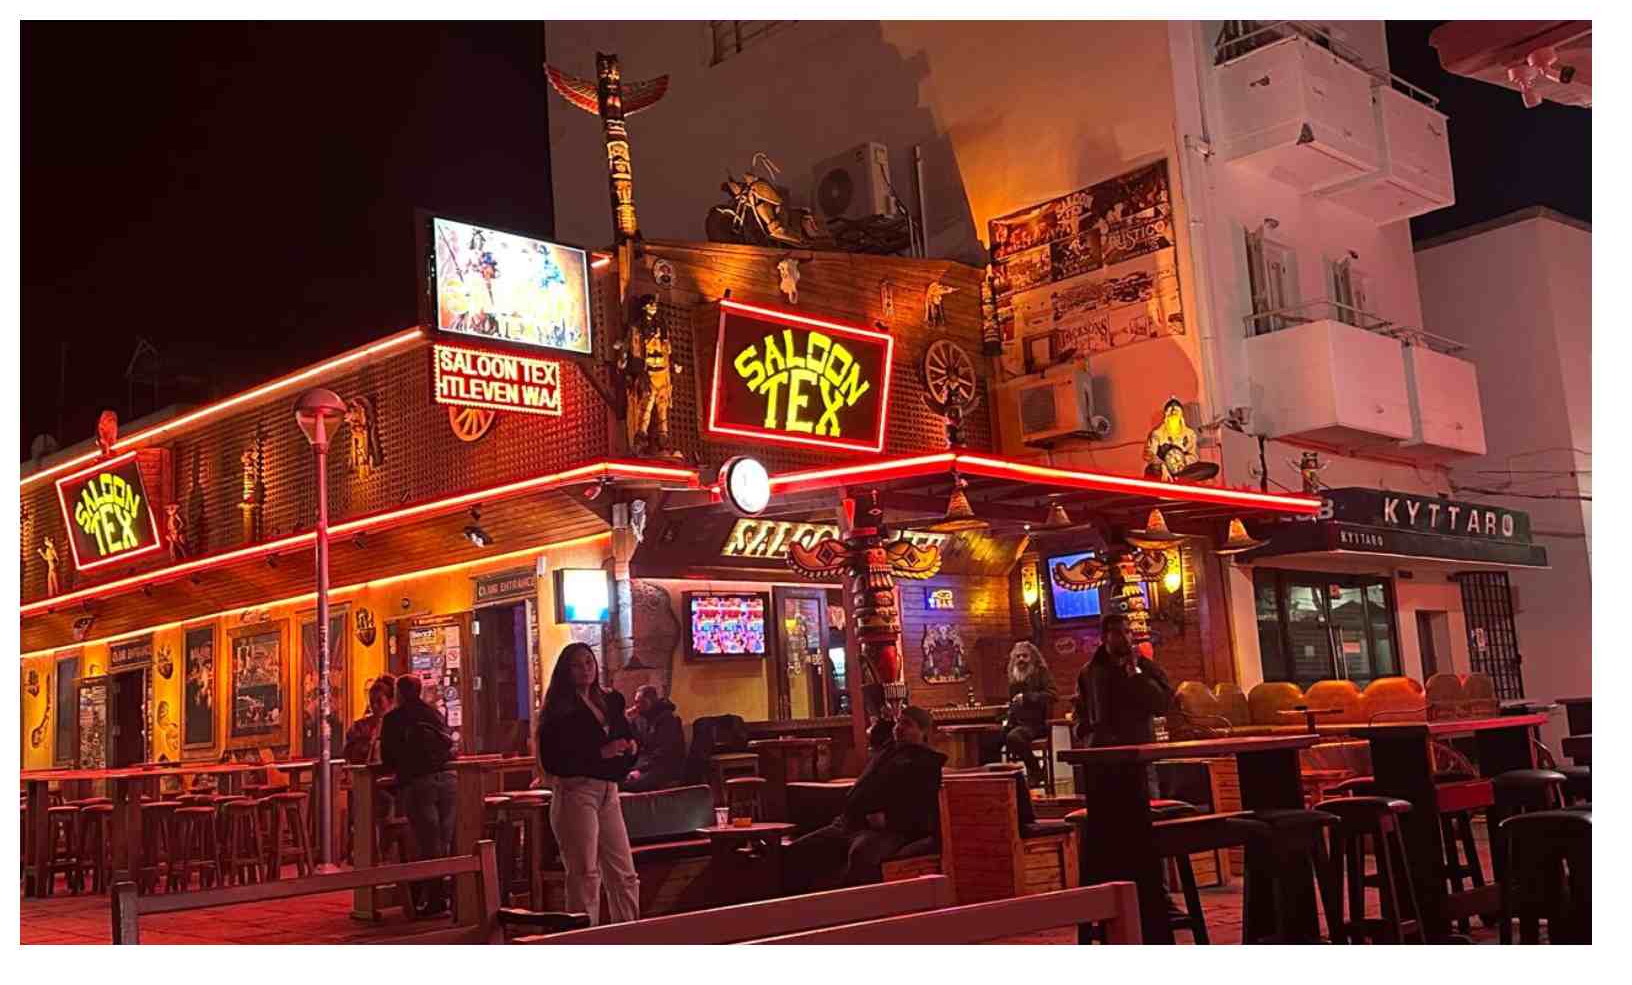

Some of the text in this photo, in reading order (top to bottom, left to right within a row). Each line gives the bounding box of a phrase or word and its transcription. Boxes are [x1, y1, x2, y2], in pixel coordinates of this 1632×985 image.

[440, 350, 559, 386] SALOON TEX
[734, 329, 870, 407] SALOON
[759, 369, 844, 437] TEX
[75, 473, 140, 534] SALOON
[90, 503, 138, 556] TEX
[1383, 497, 1514, 537] KYTTARO
[1339, 530, 1384, 548] KYTTARO
